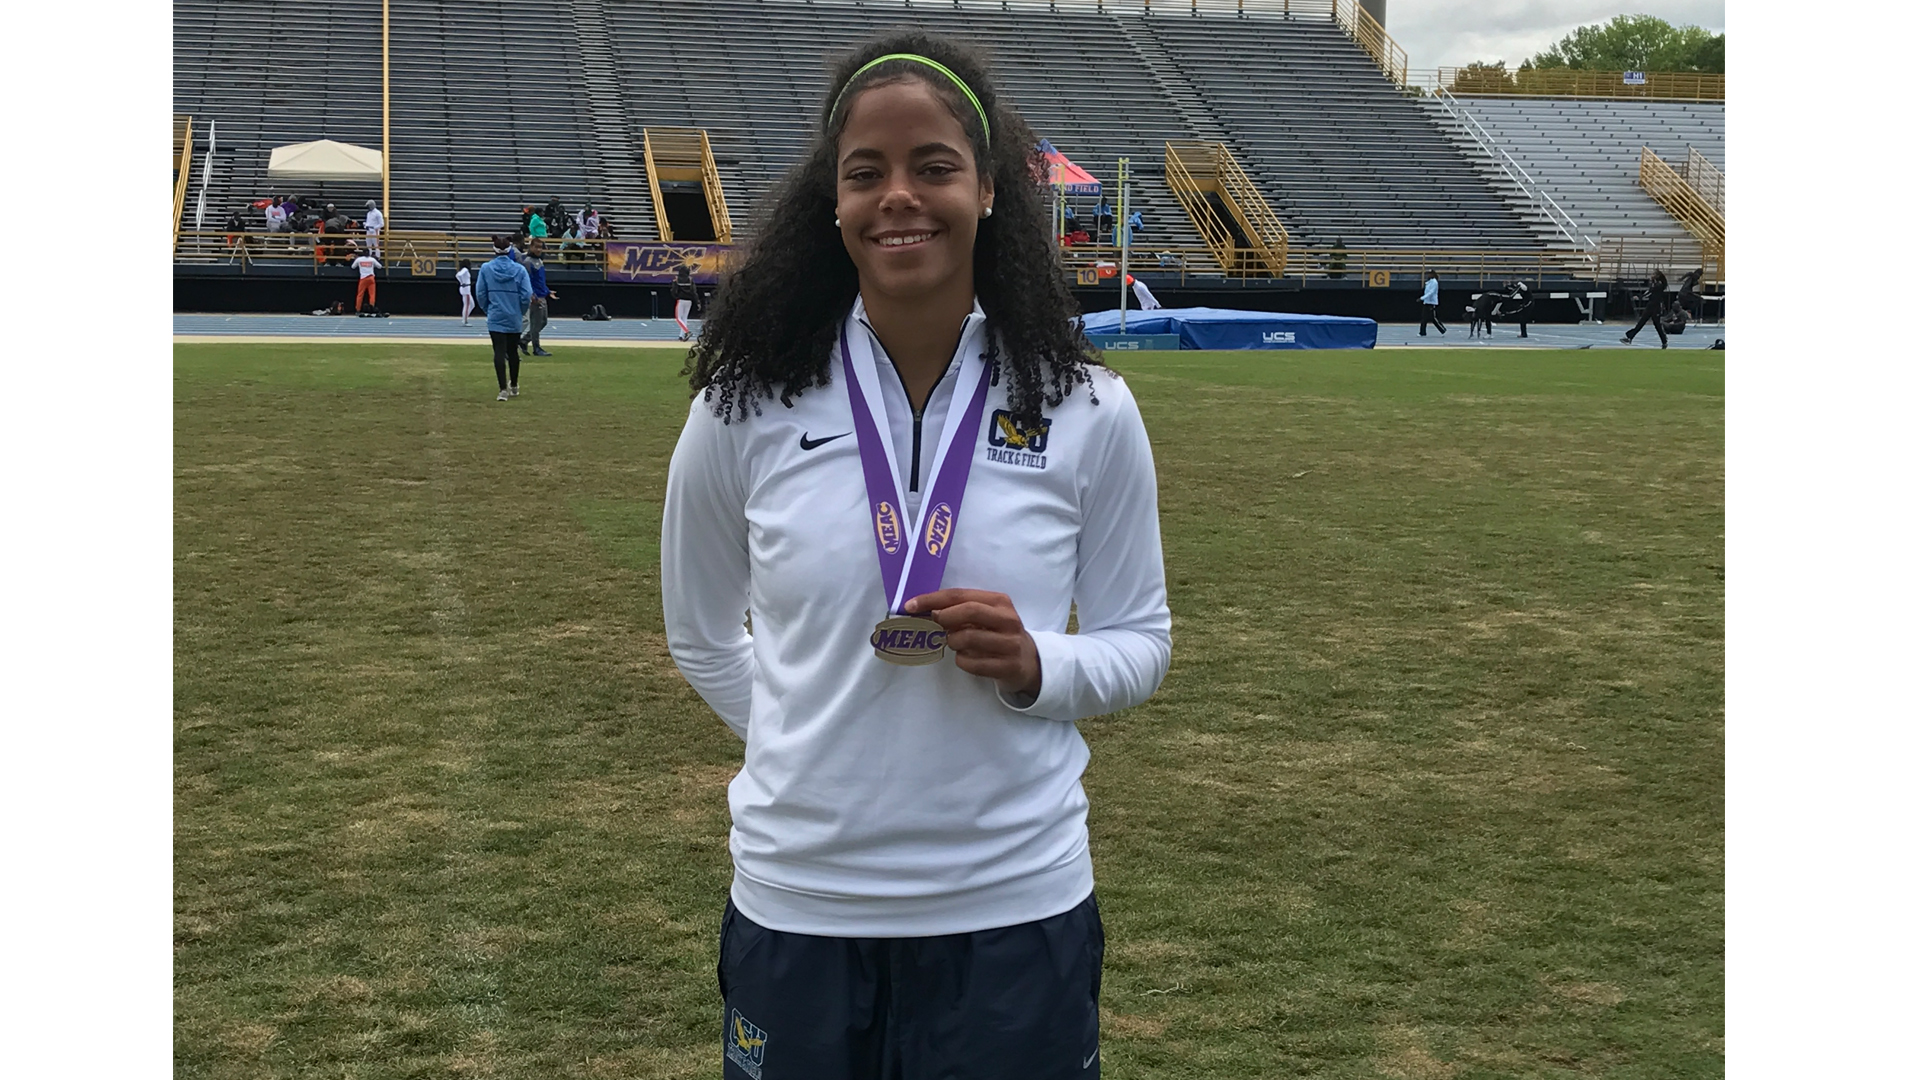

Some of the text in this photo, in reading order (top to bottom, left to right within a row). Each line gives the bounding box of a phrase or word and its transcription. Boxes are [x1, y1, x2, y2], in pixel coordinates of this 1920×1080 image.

[1075, 184, 1099, 193] FIELD
[414, 259, 434, 274] 30
[620, 246, 707, 280] MEAC
[1080, 269, 1097, 283] 10
[1373, 271, 1386, 286] G
[1262, 331, 1296, 340] UCS
[1105, 341, 1139, 350] UCS
[986, 447, 1015, 465] TRACK
[1021, 453, 1047, 470] FIELD
[876, 501, 899, 554] MEAC
[927, 503, 952, 558] MEAC
[876, 629, 947, 651] MEAC
